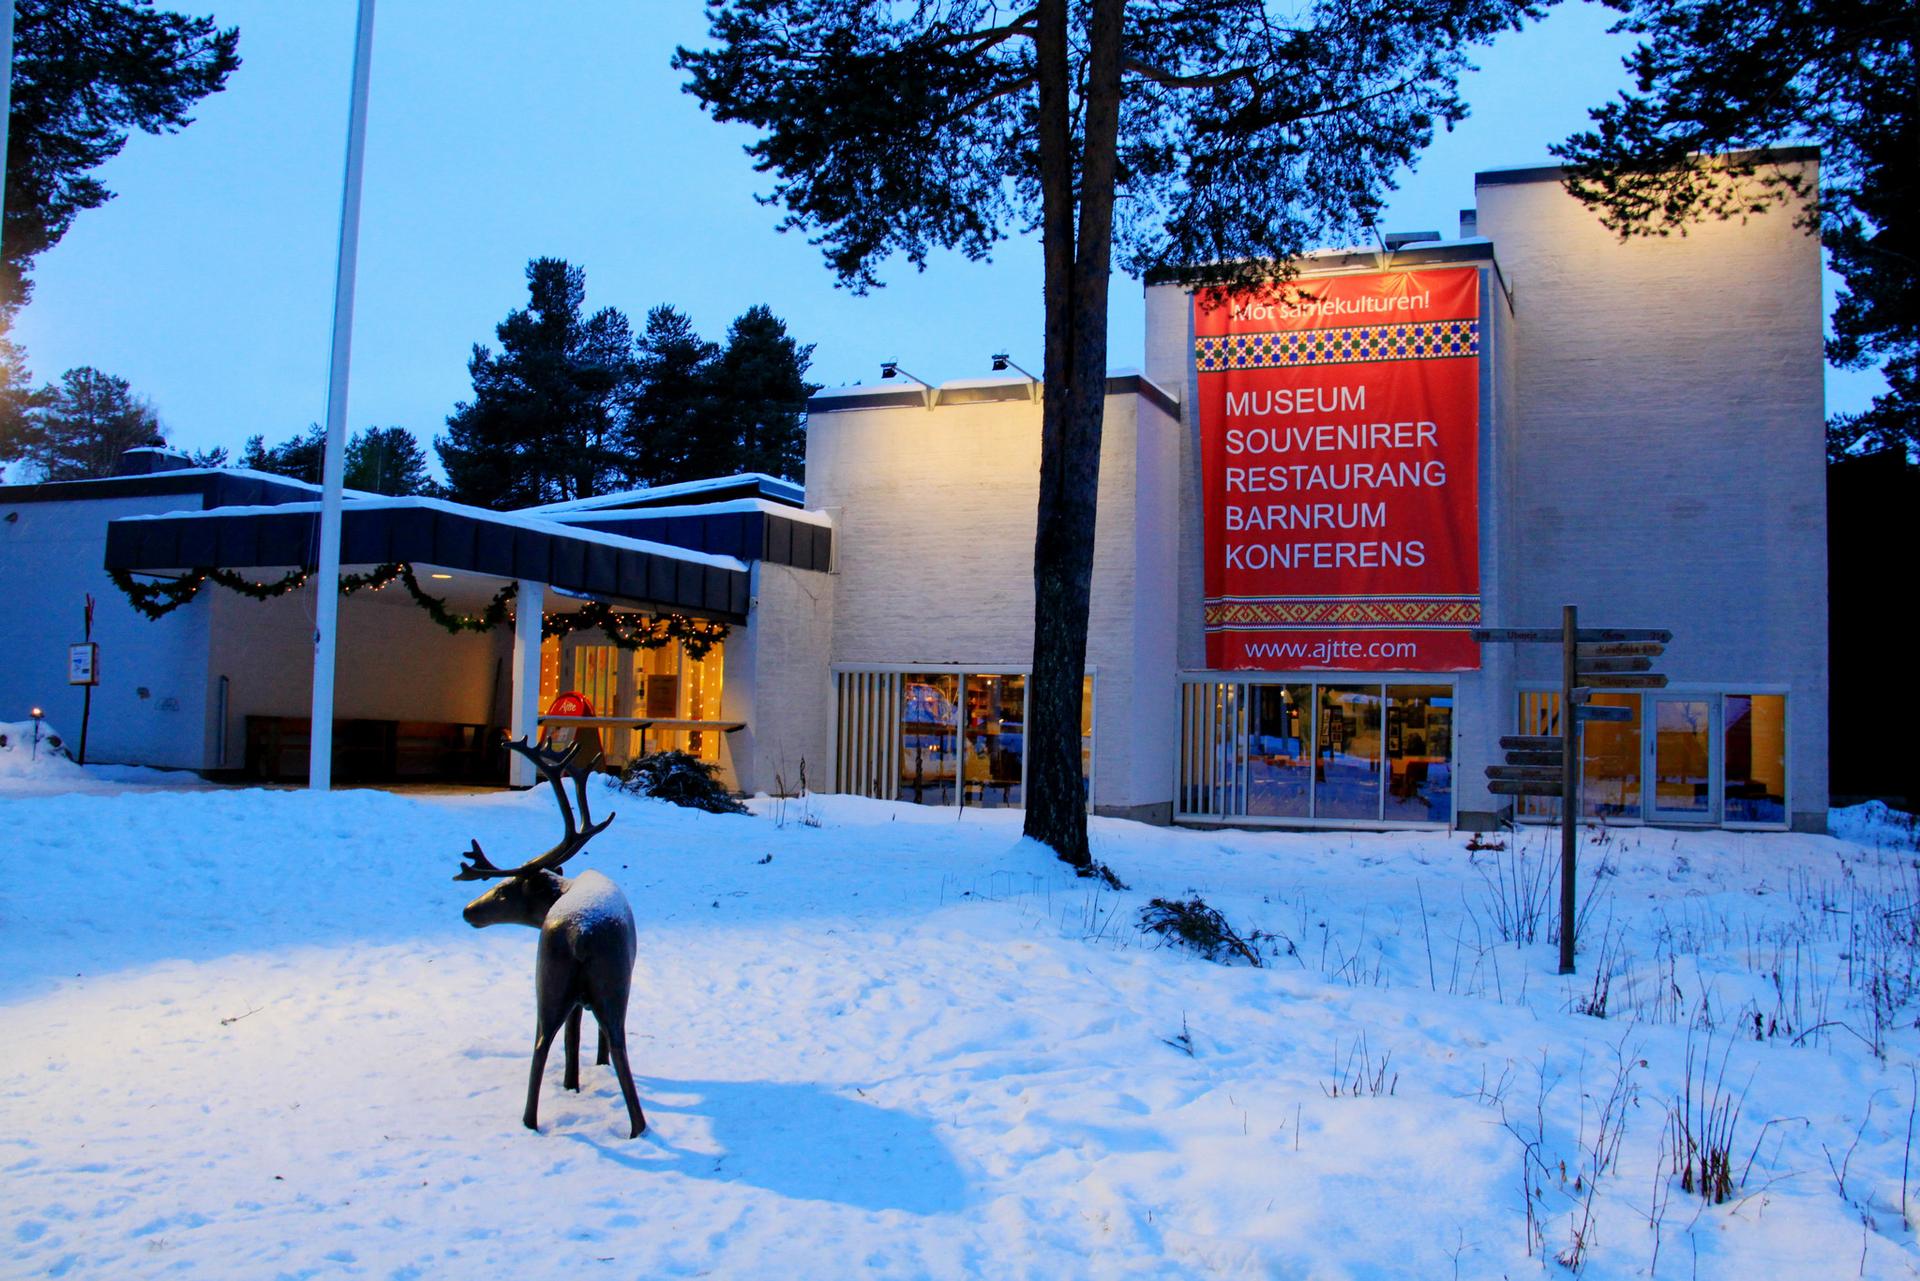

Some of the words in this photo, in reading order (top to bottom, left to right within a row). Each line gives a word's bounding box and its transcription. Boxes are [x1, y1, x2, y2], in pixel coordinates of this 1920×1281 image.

[1232, 301, 1275, 322] Möt
[1280, 290, 1430, 319] samekulturen!
[1226, 385, 1366, 416] MUSEUM
[1225, 421, 1438, 455] SOUVENIRER
[1226, 460, 1446, 493] RESTAURANG
[1226, 502, 1386, 530] BARNRUM
[1226, 540, 1425, 570] KONFERENS
[1244, 639, 1417, 663] www.ajtte.com
